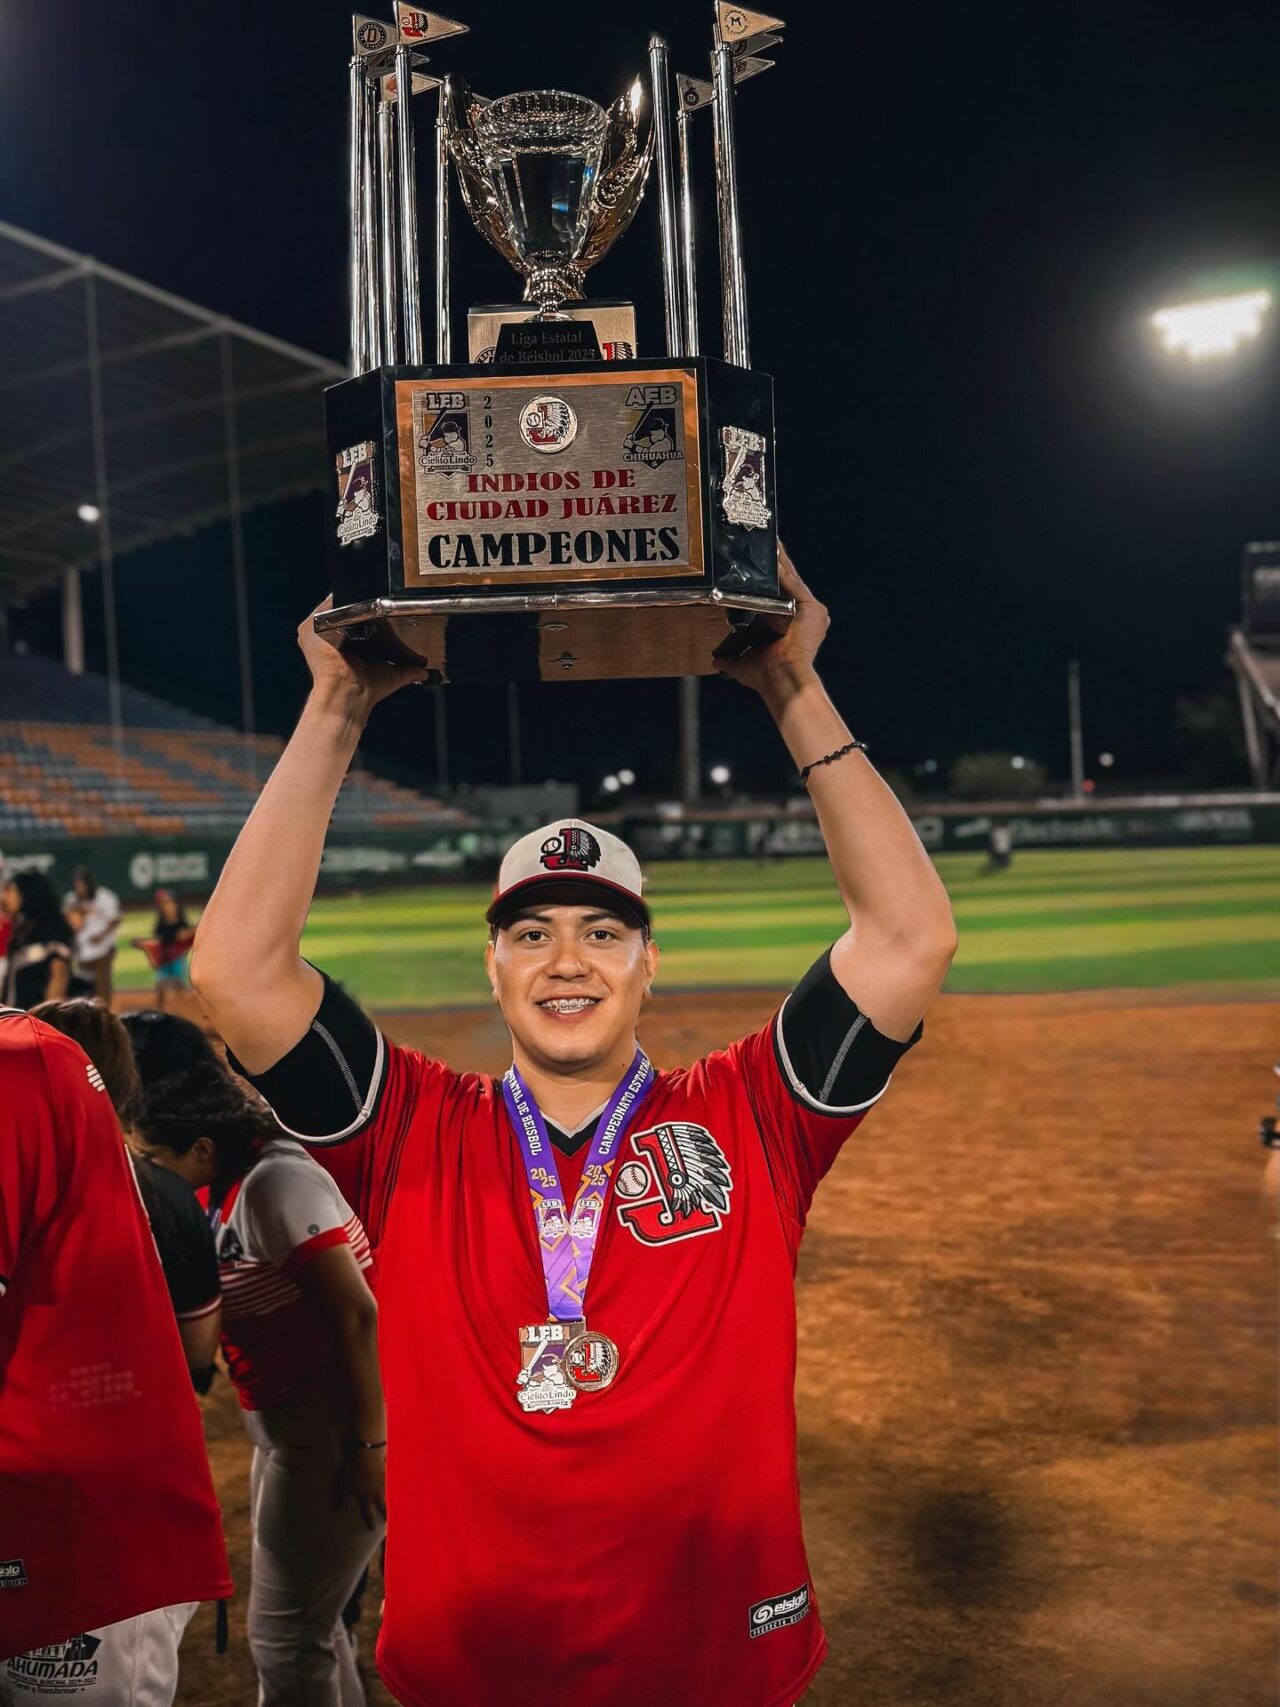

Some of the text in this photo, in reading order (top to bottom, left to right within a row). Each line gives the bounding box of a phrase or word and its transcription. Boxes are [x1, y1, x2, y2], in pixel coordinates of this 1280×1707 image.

[511, 330, 582, 348] Liga Estatal
[427, 392, 466, 410] LEB
[626, 386, 677, 406] AEB
[342, 442, 368, 468] LEB
[623, 451, 685, 463] CHIHUAHUA
[467, 469, 636, 493] INDIOS DE
[427, 491, 678, 522] CIUDAD JUÁREZ
[428, 527, 681, 568] CAMPEONES
[516, 1101, 530, 1116] DE
[598, 1091, 635, 1155] CAMPEONATO
[521, 1113, 543, 1156] BEISBOL
[528, 1325, 564, 1342] LEB
[7, 1657, 98, 1678] AHUMADA
